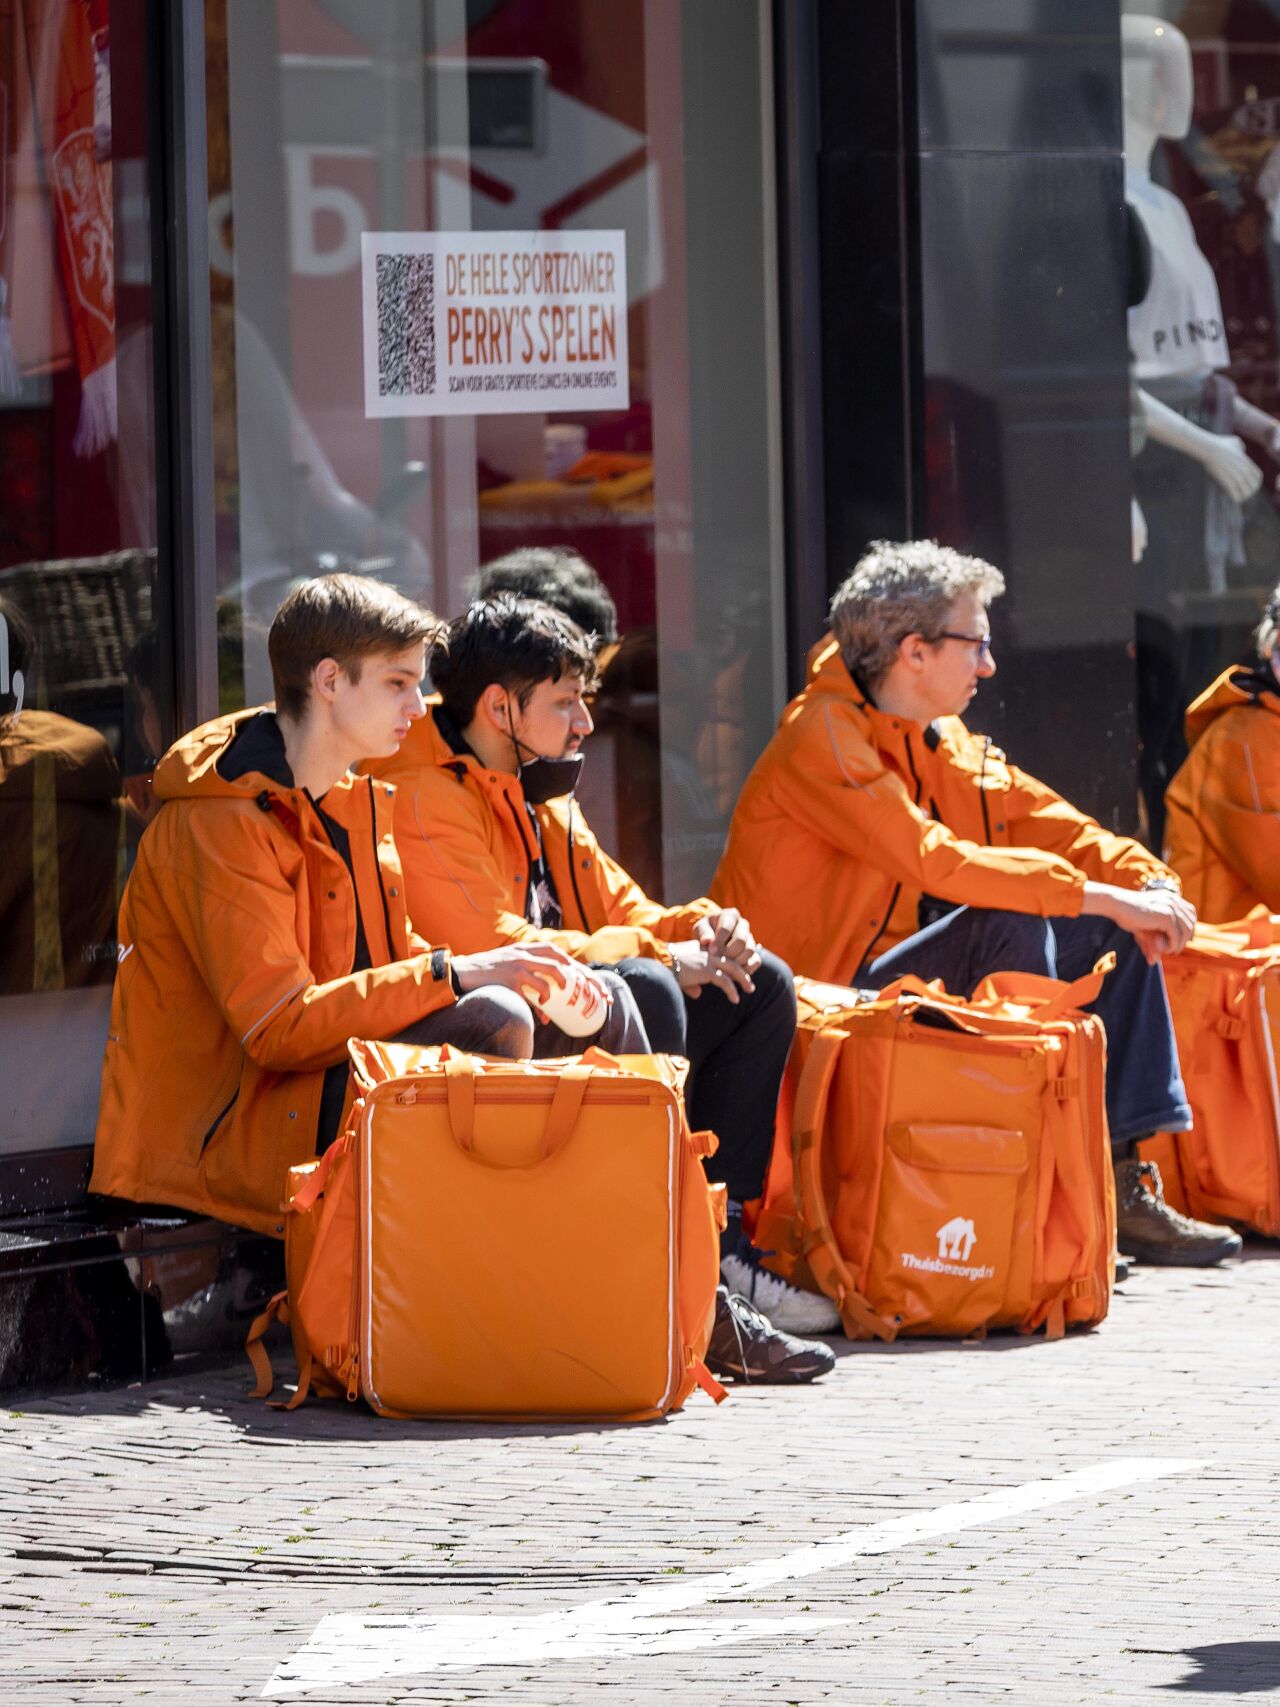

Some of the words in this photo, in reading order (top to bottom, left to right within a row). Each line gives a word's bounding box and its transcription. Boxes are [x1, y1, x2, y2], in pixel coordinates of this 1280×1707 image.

[446, 252, 466, 295] DE
[470, 252, 508, 295] HELE
[512, 251, 616, 295] SPORTZOMER
[447, 305, 534, 366] PERRY'S
[538, 304, 617, 363] SPELEN
[448, 375, 464, 393] SCAN
[465, 375, 483, 392] VOOR
